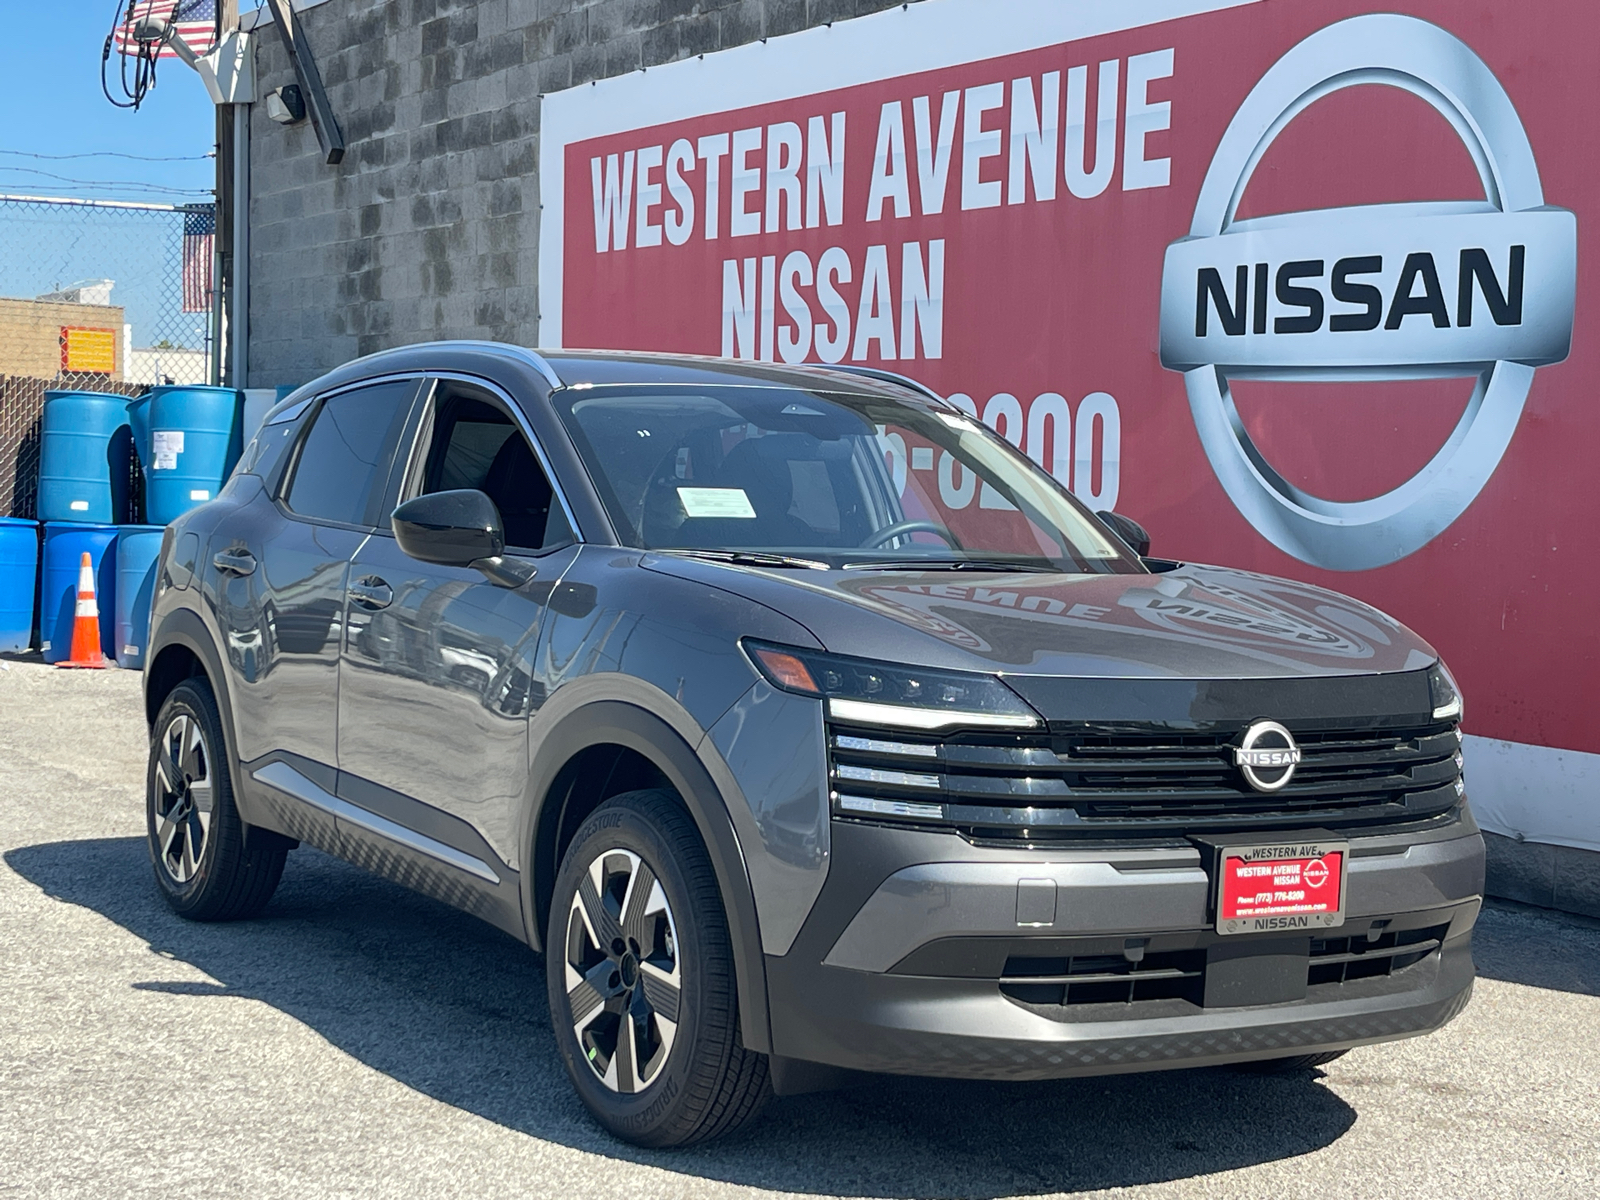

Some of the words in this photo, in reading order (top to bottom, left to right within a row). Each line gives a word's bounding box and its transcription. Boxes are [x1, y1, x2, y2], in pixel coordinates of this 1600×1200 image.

[591, 111, 847, 254] WESTERN
[865, 47, 1176, 222] AVENUE
[1195, 244, 1526, 338] NISSAN
[721, 238, 946, 364] NISSAN
[1239, 751, 1300, 765] NISSAN
[1252, 847, 1298, 859] WESTERN
[1236, 866, 1272, 878] WESTERN
[1272, 864, 1301, 875] AVENUE
[1273, 875, 1300, 886] NISSAN
[1255, 892, 1273, 905] (773)
[1254, 915, 1308, 930] NISSAN
